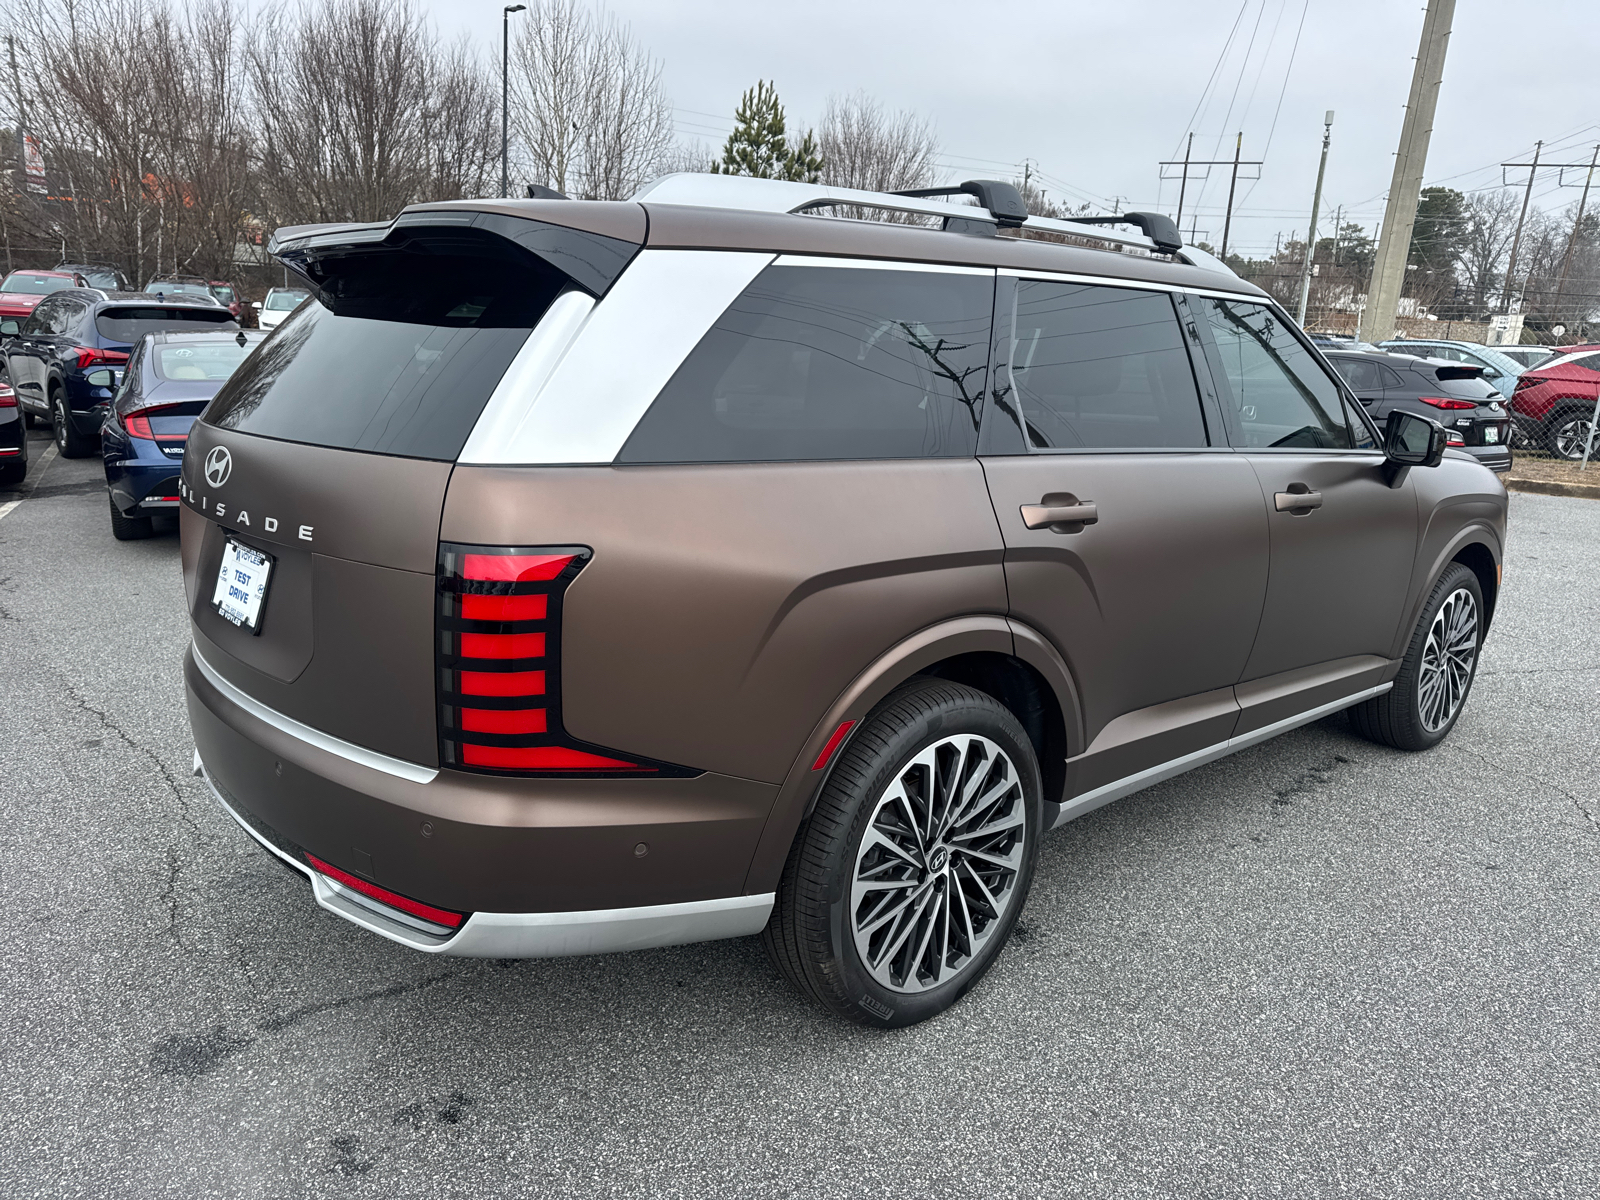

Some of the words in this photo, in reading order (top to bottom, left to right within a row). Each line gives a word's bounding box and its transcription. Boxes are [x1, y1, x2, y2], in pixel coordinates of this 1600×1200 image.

[234, 569, 251, 586] TEST
[228, 585, 249, 604] DRIVE
[224, 611, 241, 627] VOYLES
[841, 754, 895, 863] SCORPION
[858, 994, 895, 1021] PIRELLI
